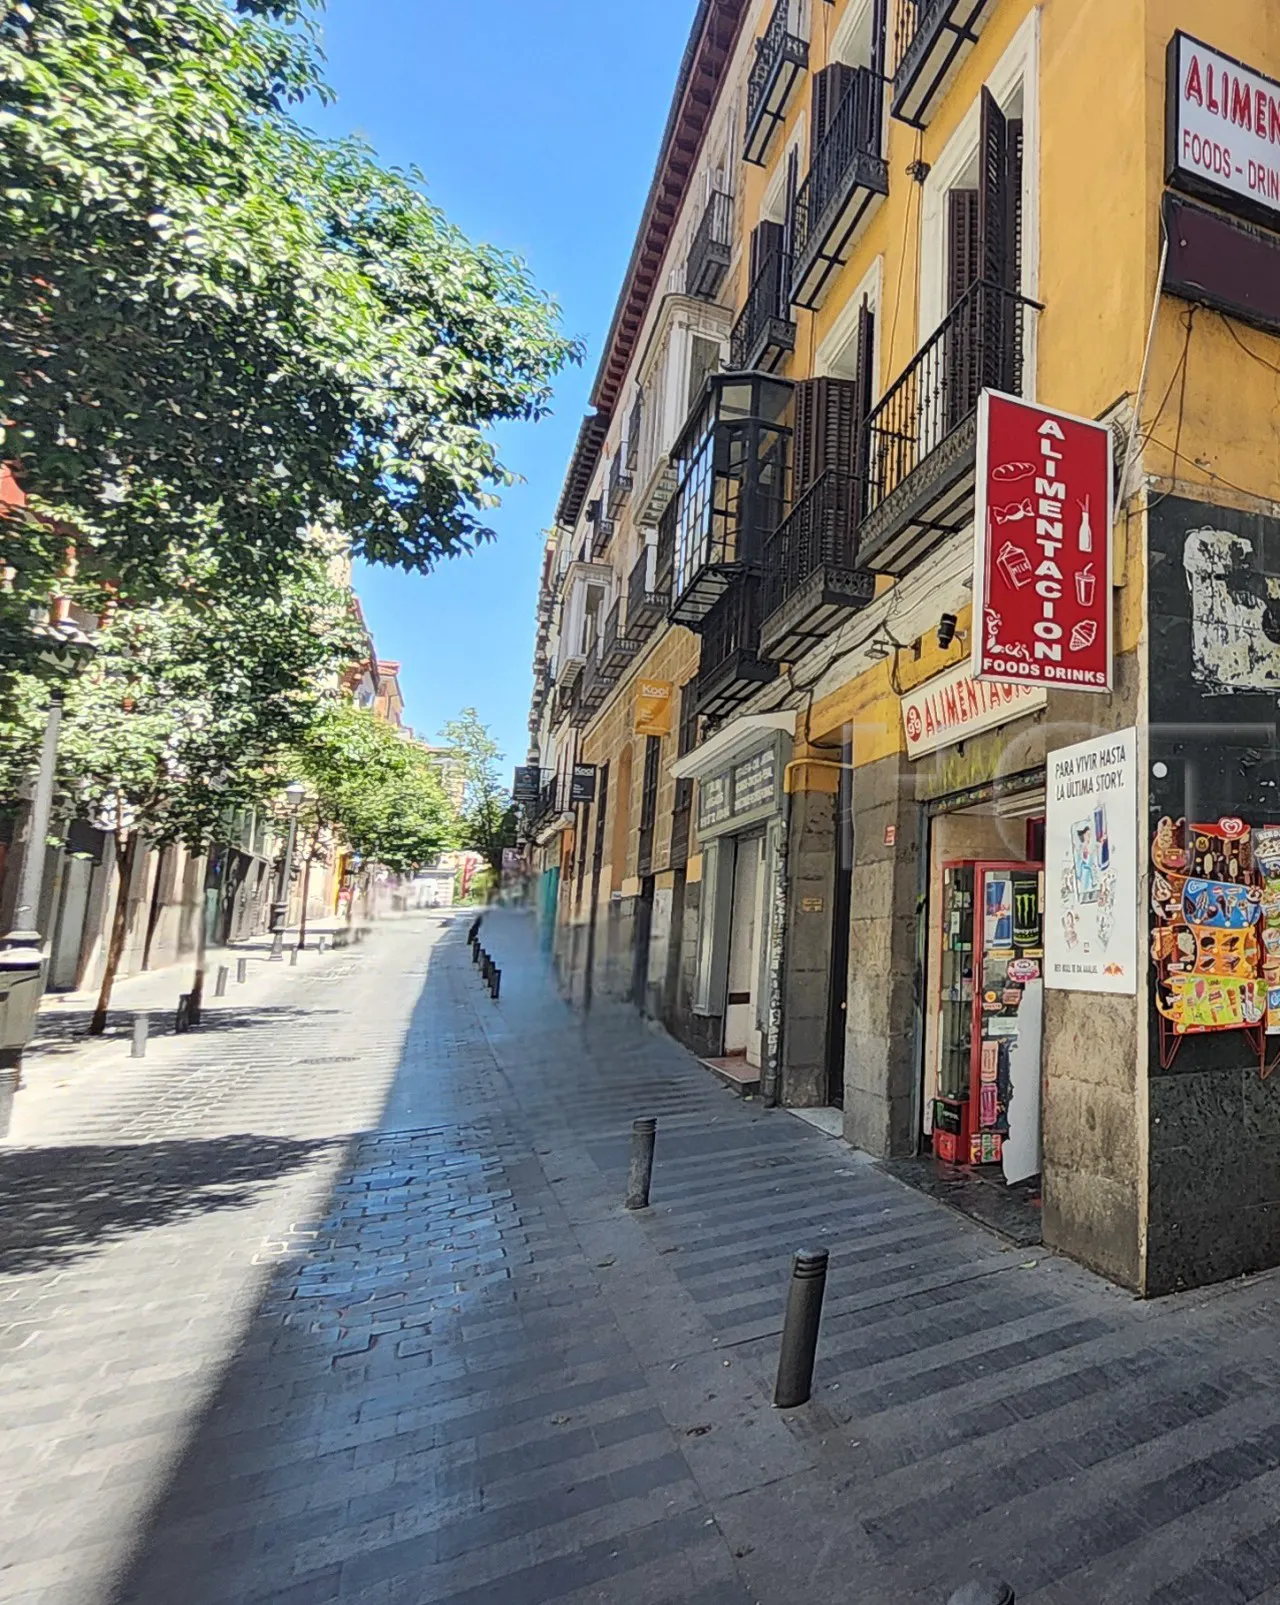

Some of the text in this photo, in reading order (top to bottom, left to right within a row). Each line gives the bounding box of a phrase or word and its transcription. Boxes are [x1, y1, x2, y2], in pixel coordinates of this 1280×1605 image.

[1183, 129, 1231, 178] FOODS
[1034, 419, 1066, 662] ALIMENTACION
[983, 658, 1106, 684] FOODS DRINKS
[1055, 744, 1127, 780] PARA VIVIR HASTA
[1056, 769, 1125, 801] LA ÚLTIMA STORY.
